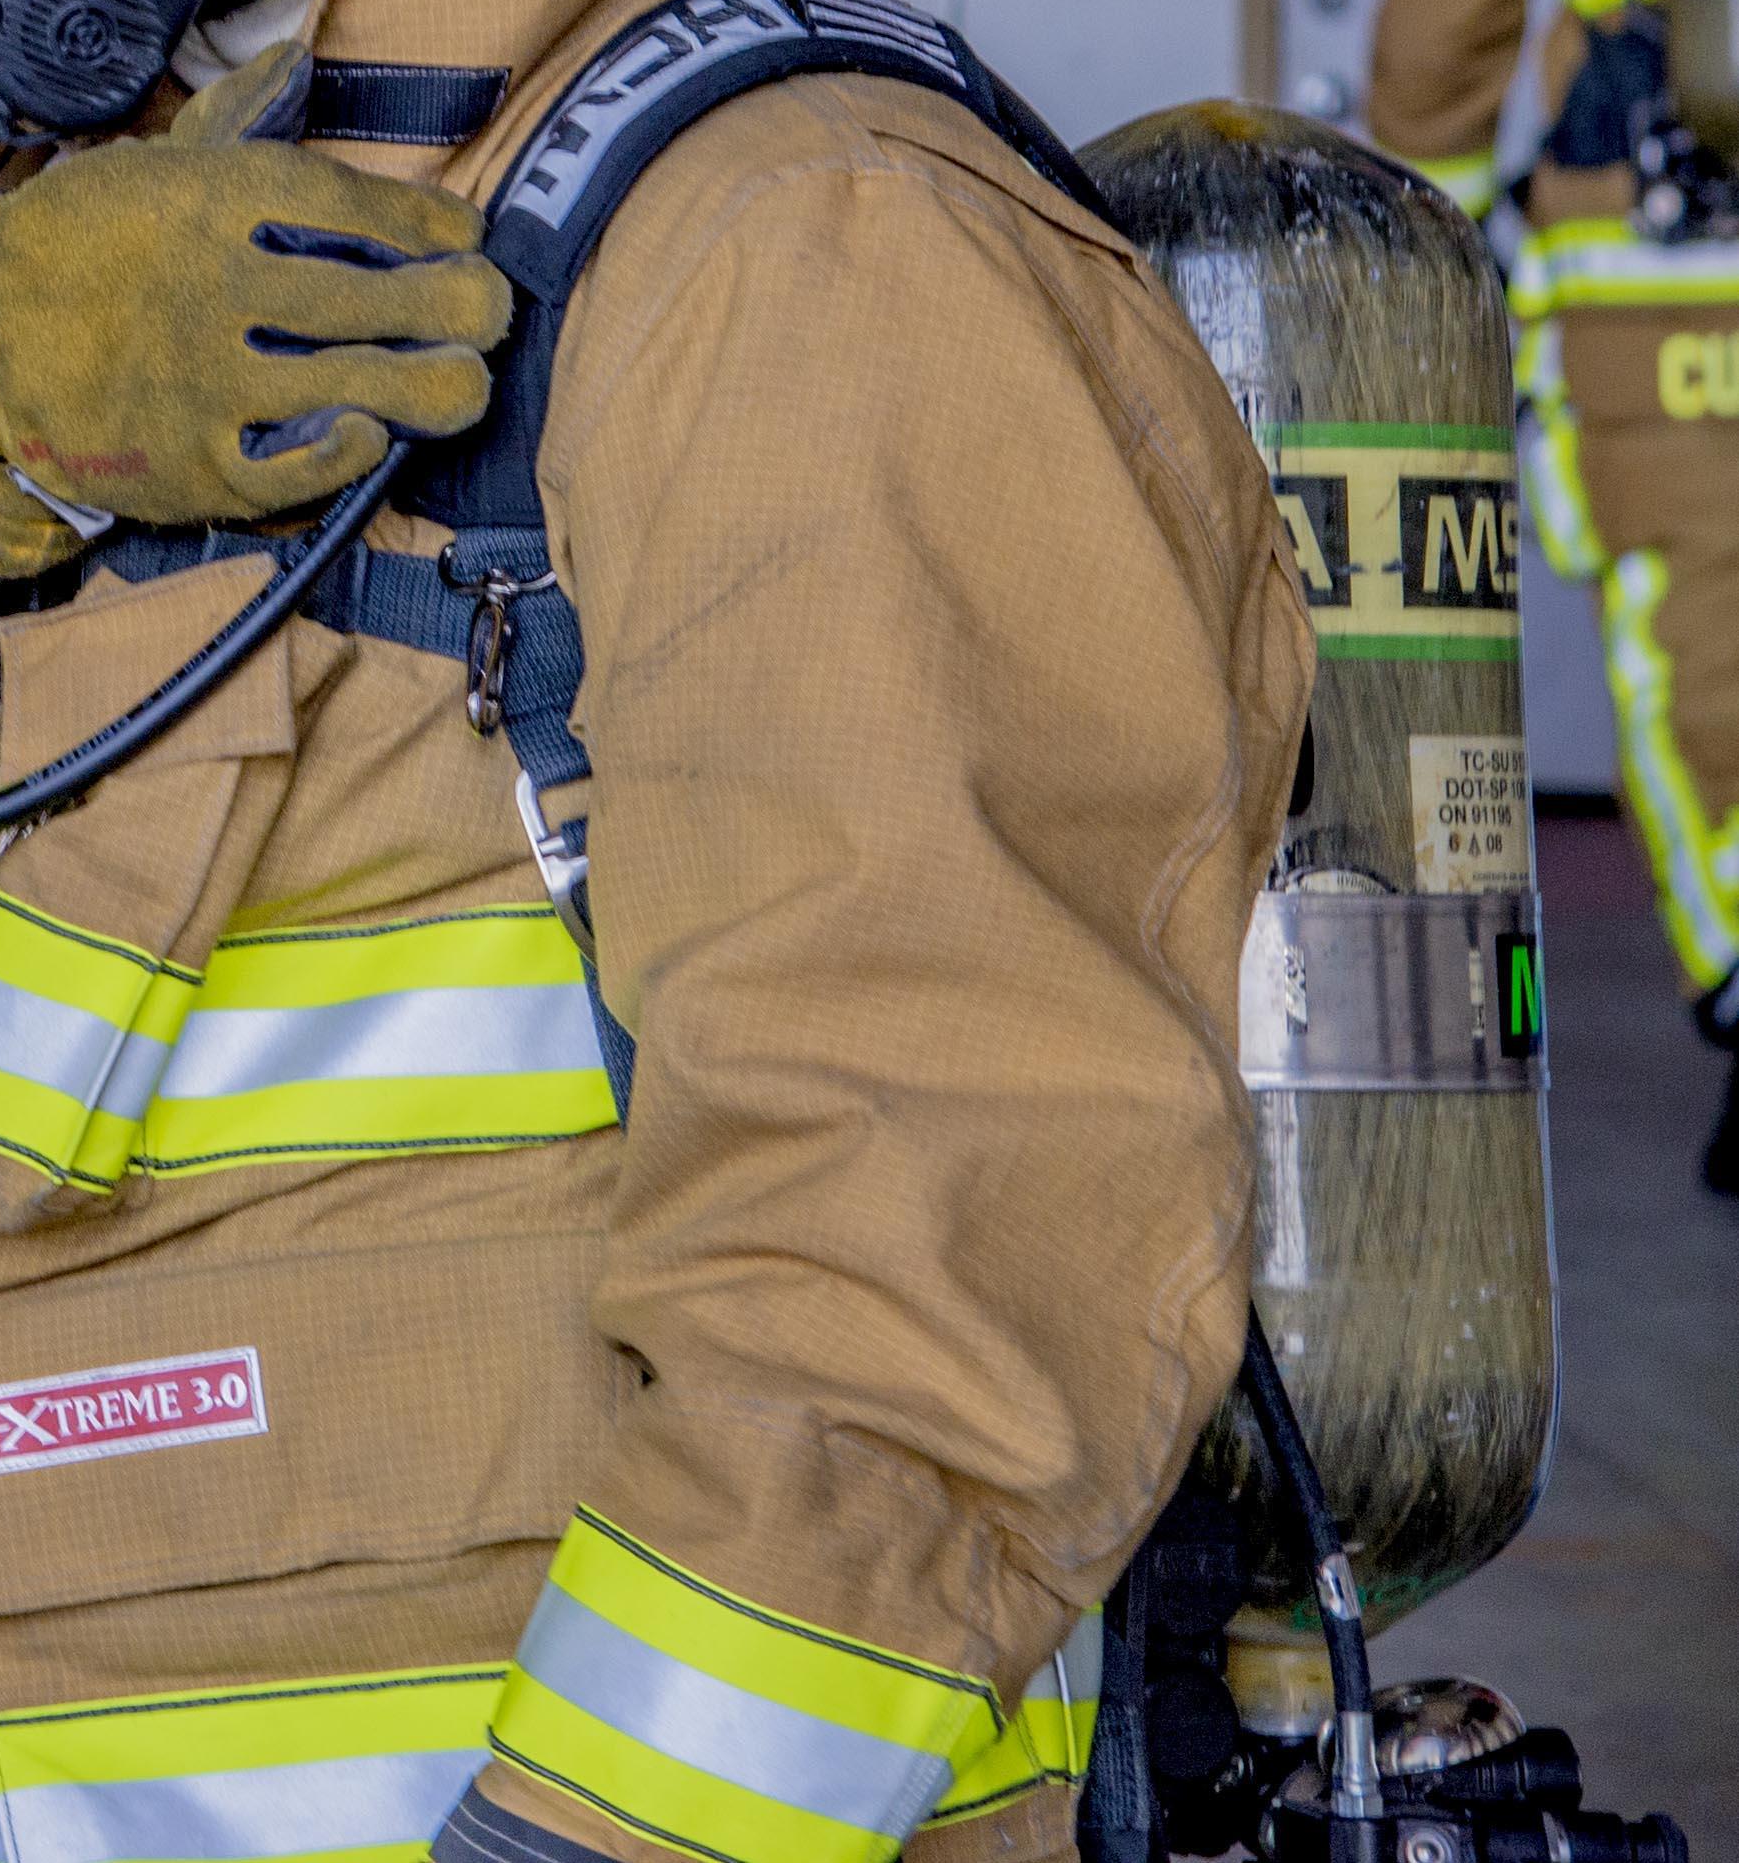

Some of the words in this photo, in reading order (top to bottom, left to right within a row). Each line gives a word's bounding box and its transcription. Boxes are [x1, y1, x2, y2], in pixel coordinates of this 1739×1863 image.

[1445, 777, 1508, 801] DOT-SP
[1438, 803, 1467, 826] ON
[189, 1371, 249, 1416] 3.0
